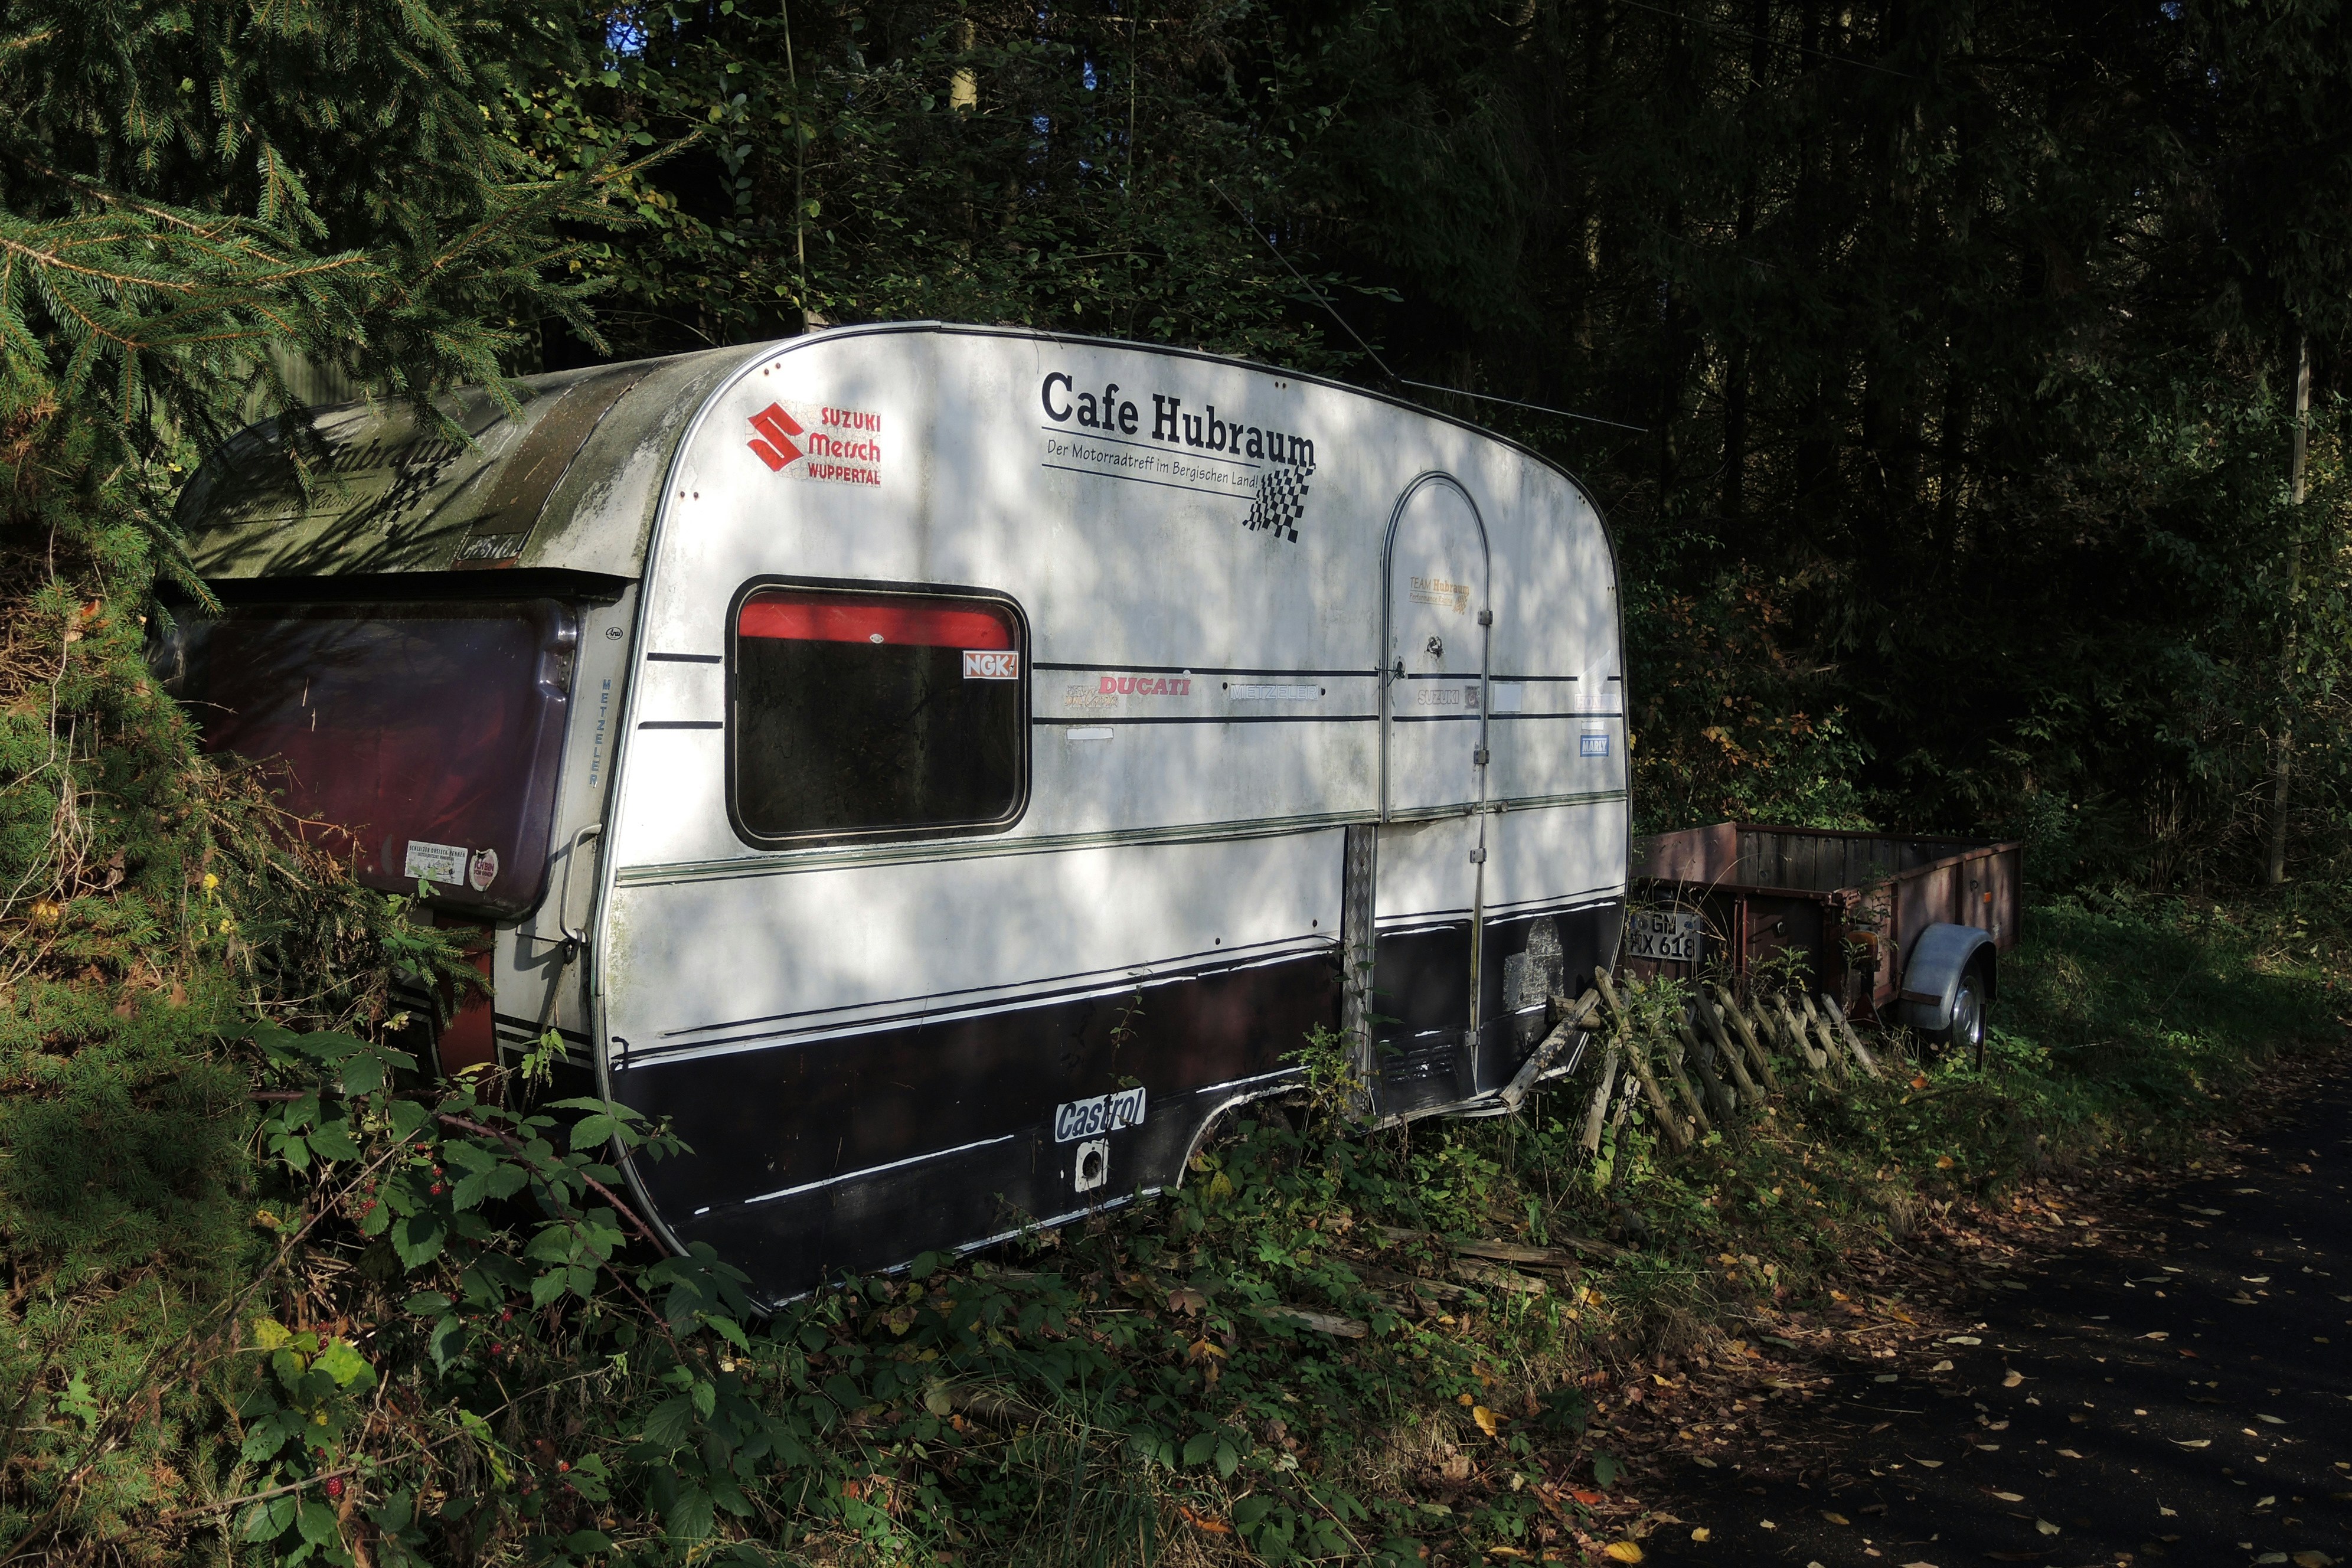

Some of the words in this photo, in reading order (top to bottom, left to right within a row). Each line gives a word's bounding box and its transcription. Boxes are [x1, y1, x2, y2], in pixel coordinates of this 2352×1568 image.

[822, 407, 880, 432] SUZUKI
[1042, 372, 1138, 435] Cafe
[1152, 393, 1316, 468] Hubraum
[808, 462, 880, 485] WUPPERTAL
[1047, 439, 1068, 456] Der
[1073, 443, 1155, 470] Motorradtreff
[1157, 460, 1168, 473] im
[1173, 462, 1228, 484] Bergischen
[1232, 472, 1257, 489] Land!
[1410, 577, 1431, 590] TEAM
[1433, 579, 1469, 596] Hubraum
[966, 655, 1008, 677] NGK
[1099, 677, 1190, 695] DUCATI
[1230, 685, 1318, 700] METZELER
[1417, 690, 1459, 705] SUZUKI
[589, 679, 611, 786] METZELER
[1582, 740, 1607, 752] MARLY
[1660, 936, 1695, 958] 618
[1057, 1090, 1144, 1140] Castrol
